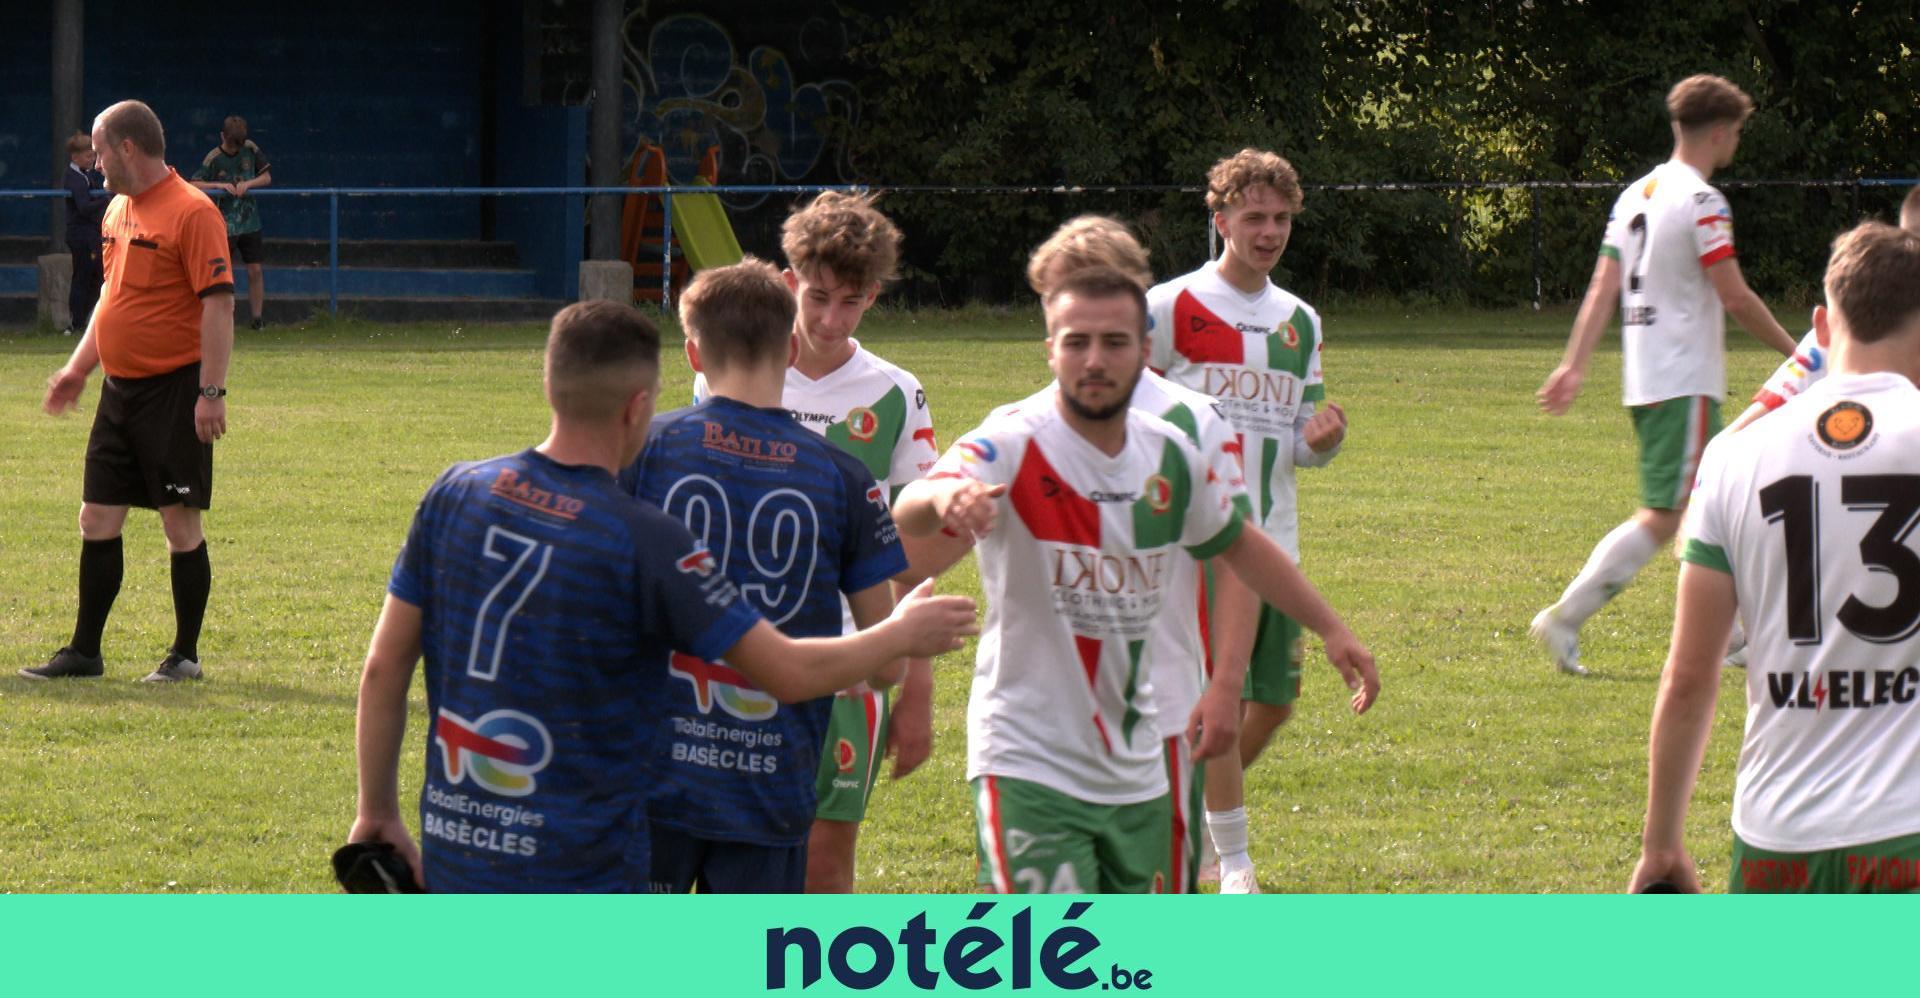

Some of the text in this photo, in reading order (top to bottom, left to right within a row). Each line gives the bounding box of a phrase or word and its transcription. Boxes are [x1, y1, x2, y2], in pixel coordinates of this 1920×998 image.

[1626, 212, 1648, 294] 2
[791, 409, 837, 425] OLYMPIC
[1758, 474, 1920, 646] 13
[466, 524, 554, 682] 7
[671, 717, 784, 749] TotalEnergies
[671, 742, 778, 774] BASÈCLES
[424, 811, 538, 857] BASÈCLES
[648, 881, 673, 894] ULT
